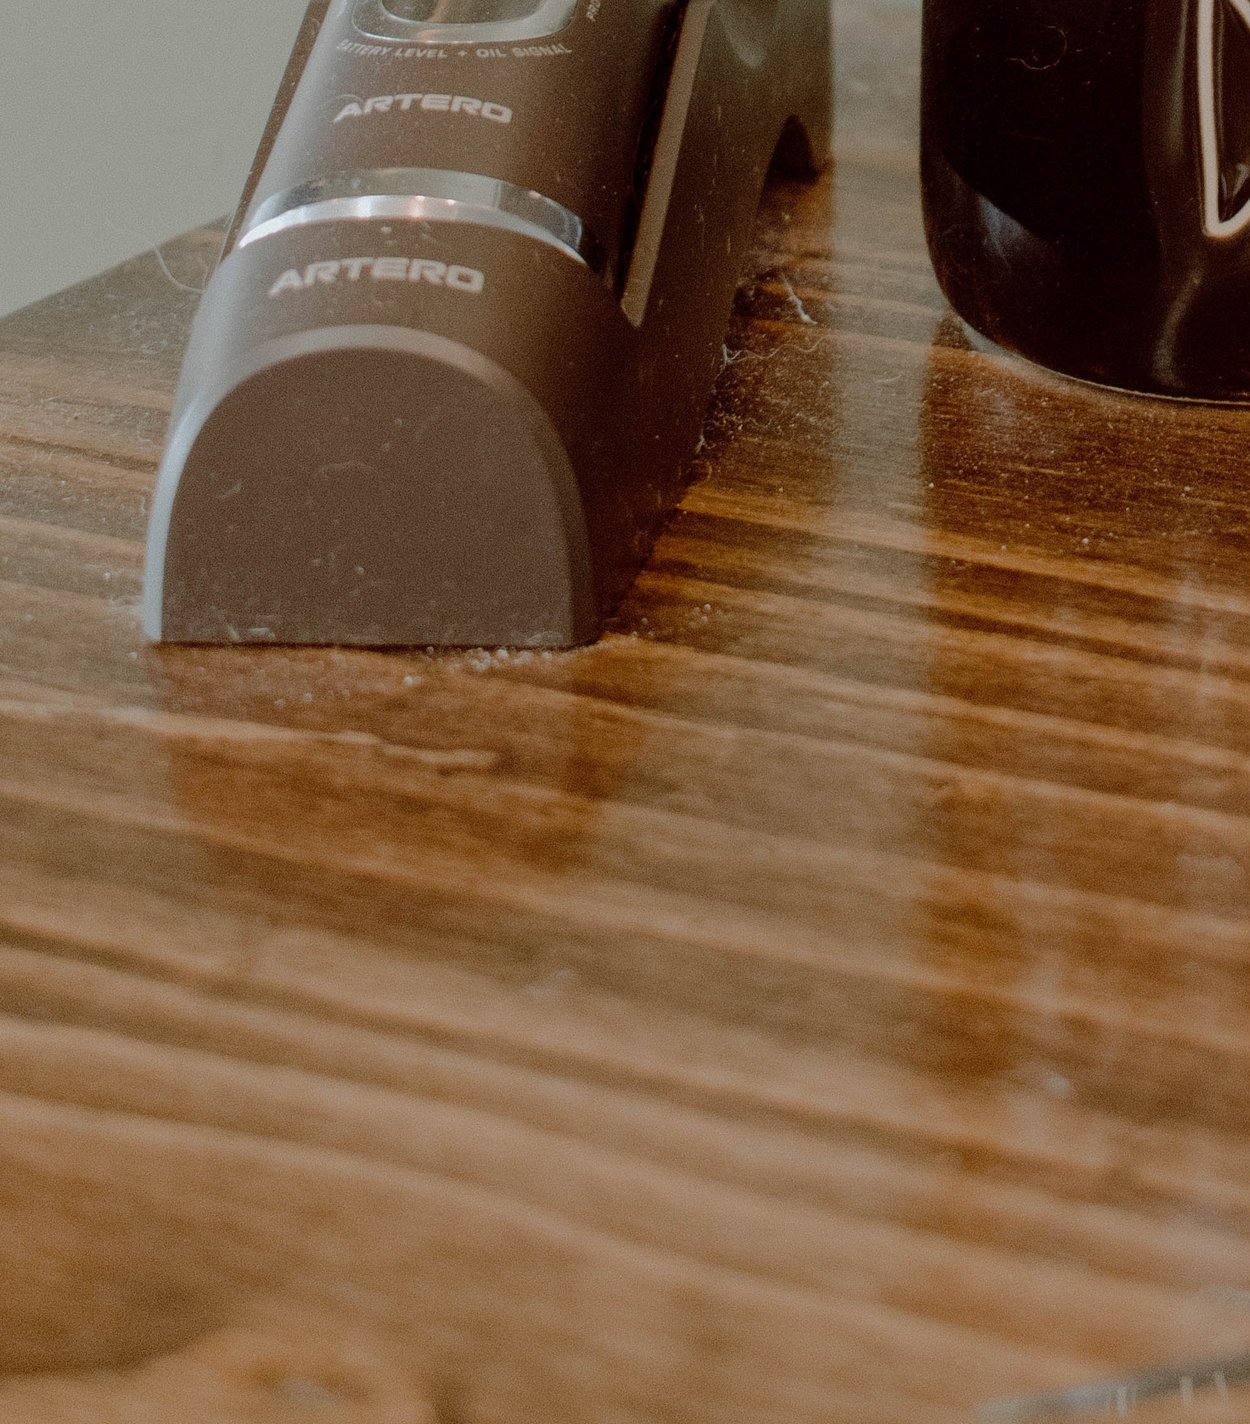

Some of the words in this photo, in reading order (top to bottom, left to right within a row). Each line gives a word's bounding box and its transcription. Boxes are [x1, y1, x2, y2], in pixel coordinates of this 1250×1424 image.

[395, 47, 448, 59] LEVEL
[476, 48, 506, 58] OIL
[512, 43, 573, 58] SIGNAL
[332, 92, 514, 124] ARTERO
[268, 256, 485, 298] ARTERO
